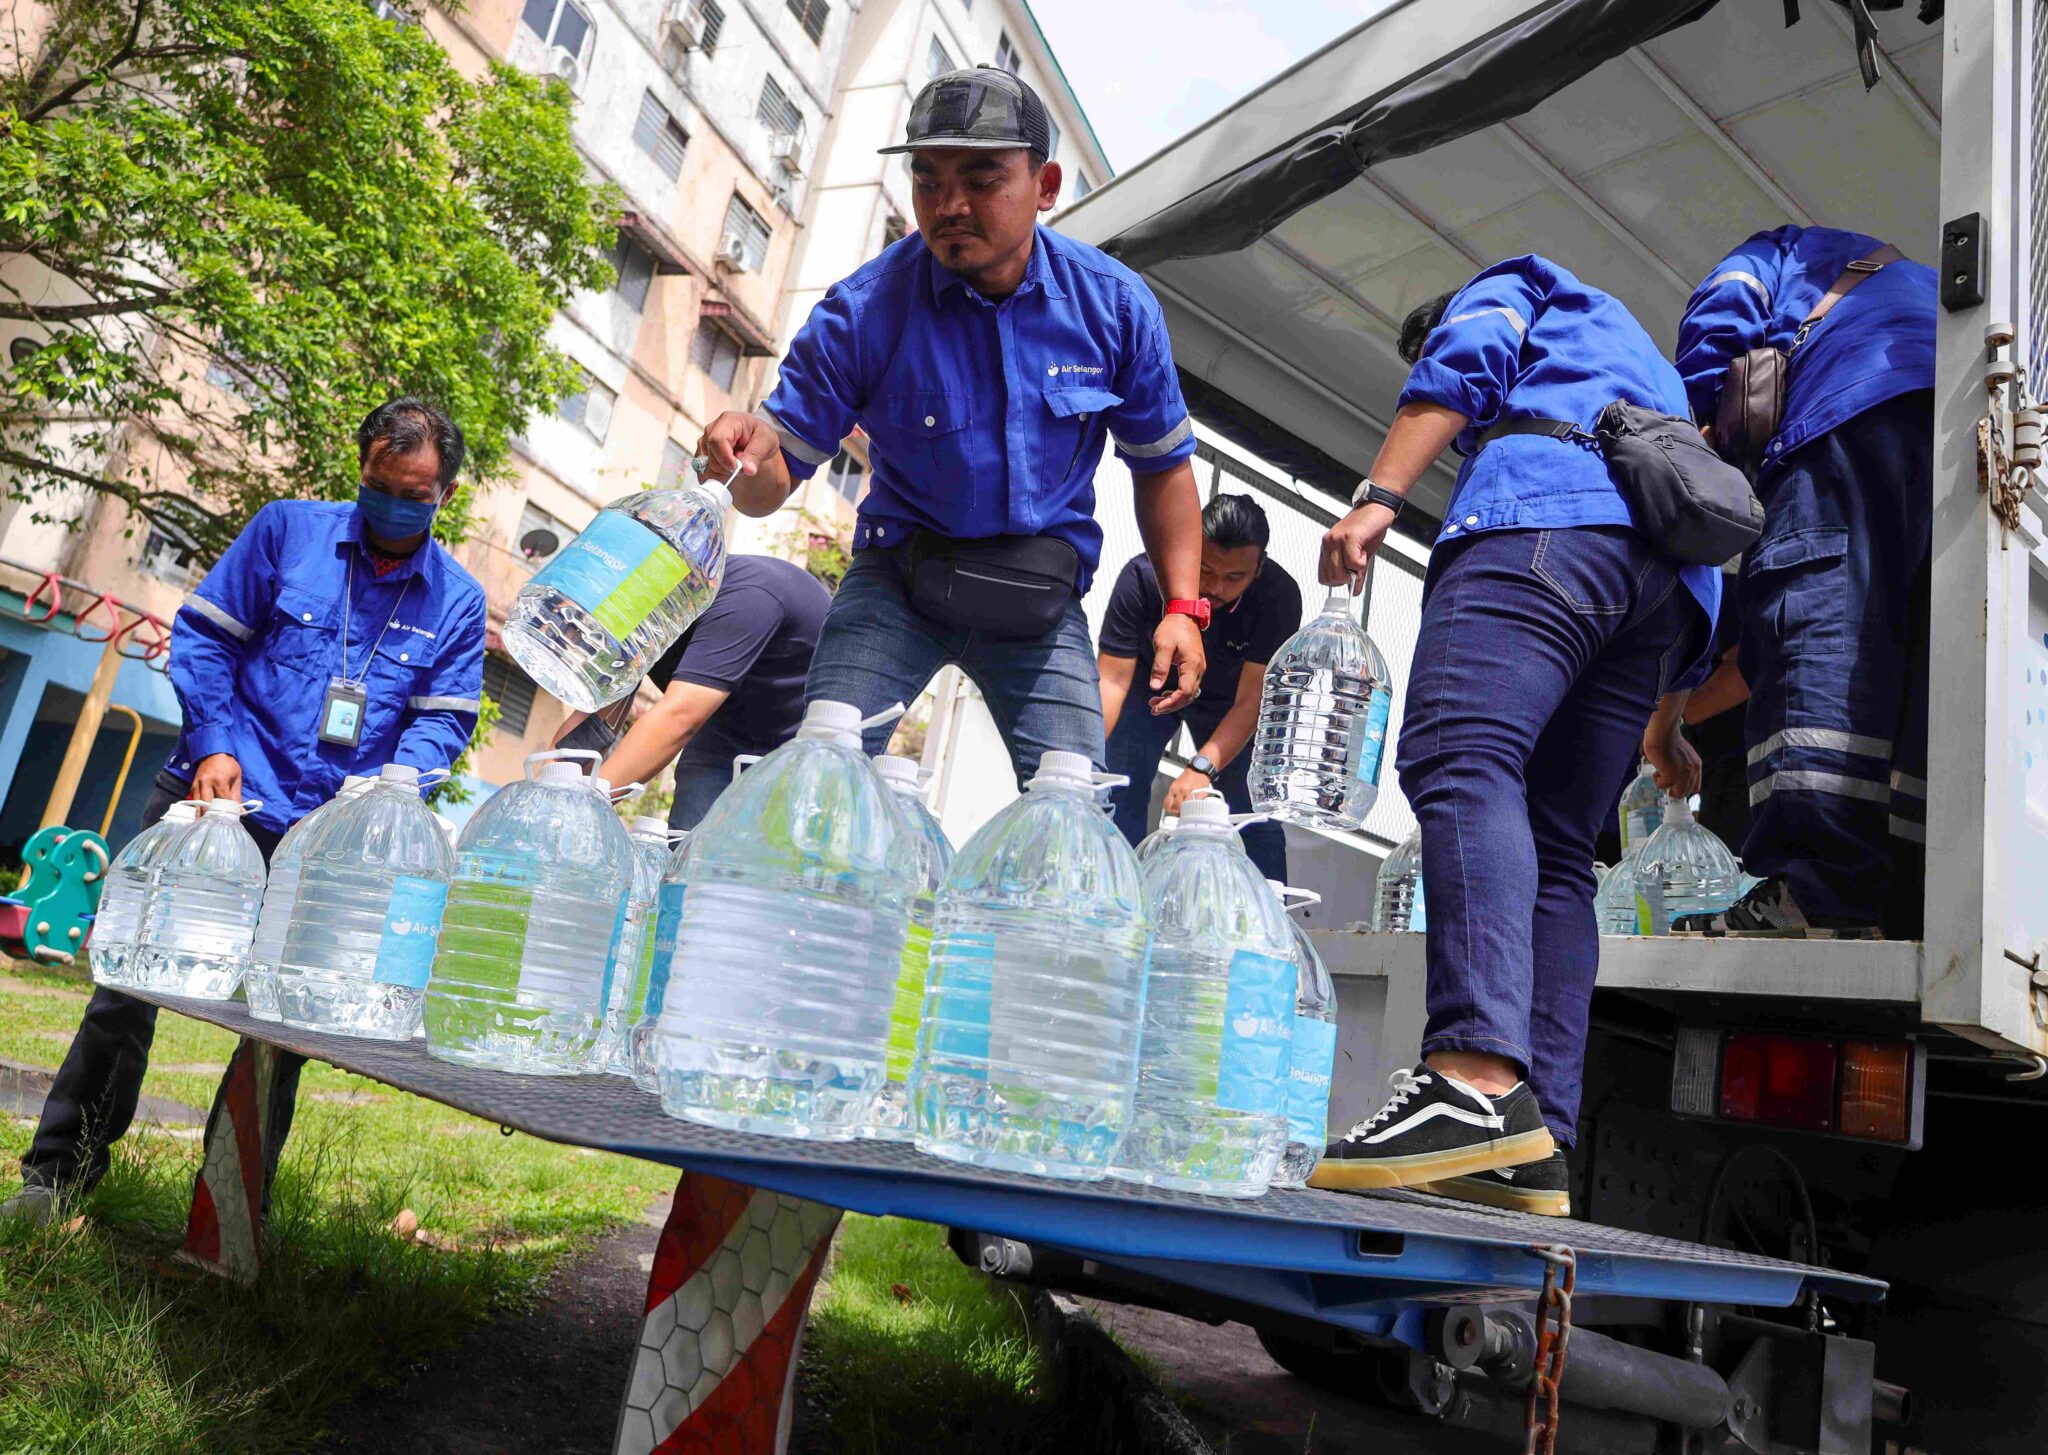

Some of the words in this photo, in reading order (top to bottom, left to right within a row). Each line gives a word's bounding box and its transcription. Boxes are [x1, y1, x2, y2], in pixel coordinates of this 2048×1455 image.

[1061, 364, 1072, 374] Air
[1072, 364, 1104, 376] Selangor
[581, 540, 628, 571] Selangor
[412, 921, 429, 935] Air
[1260, 1018, 1278, 1036] Air
